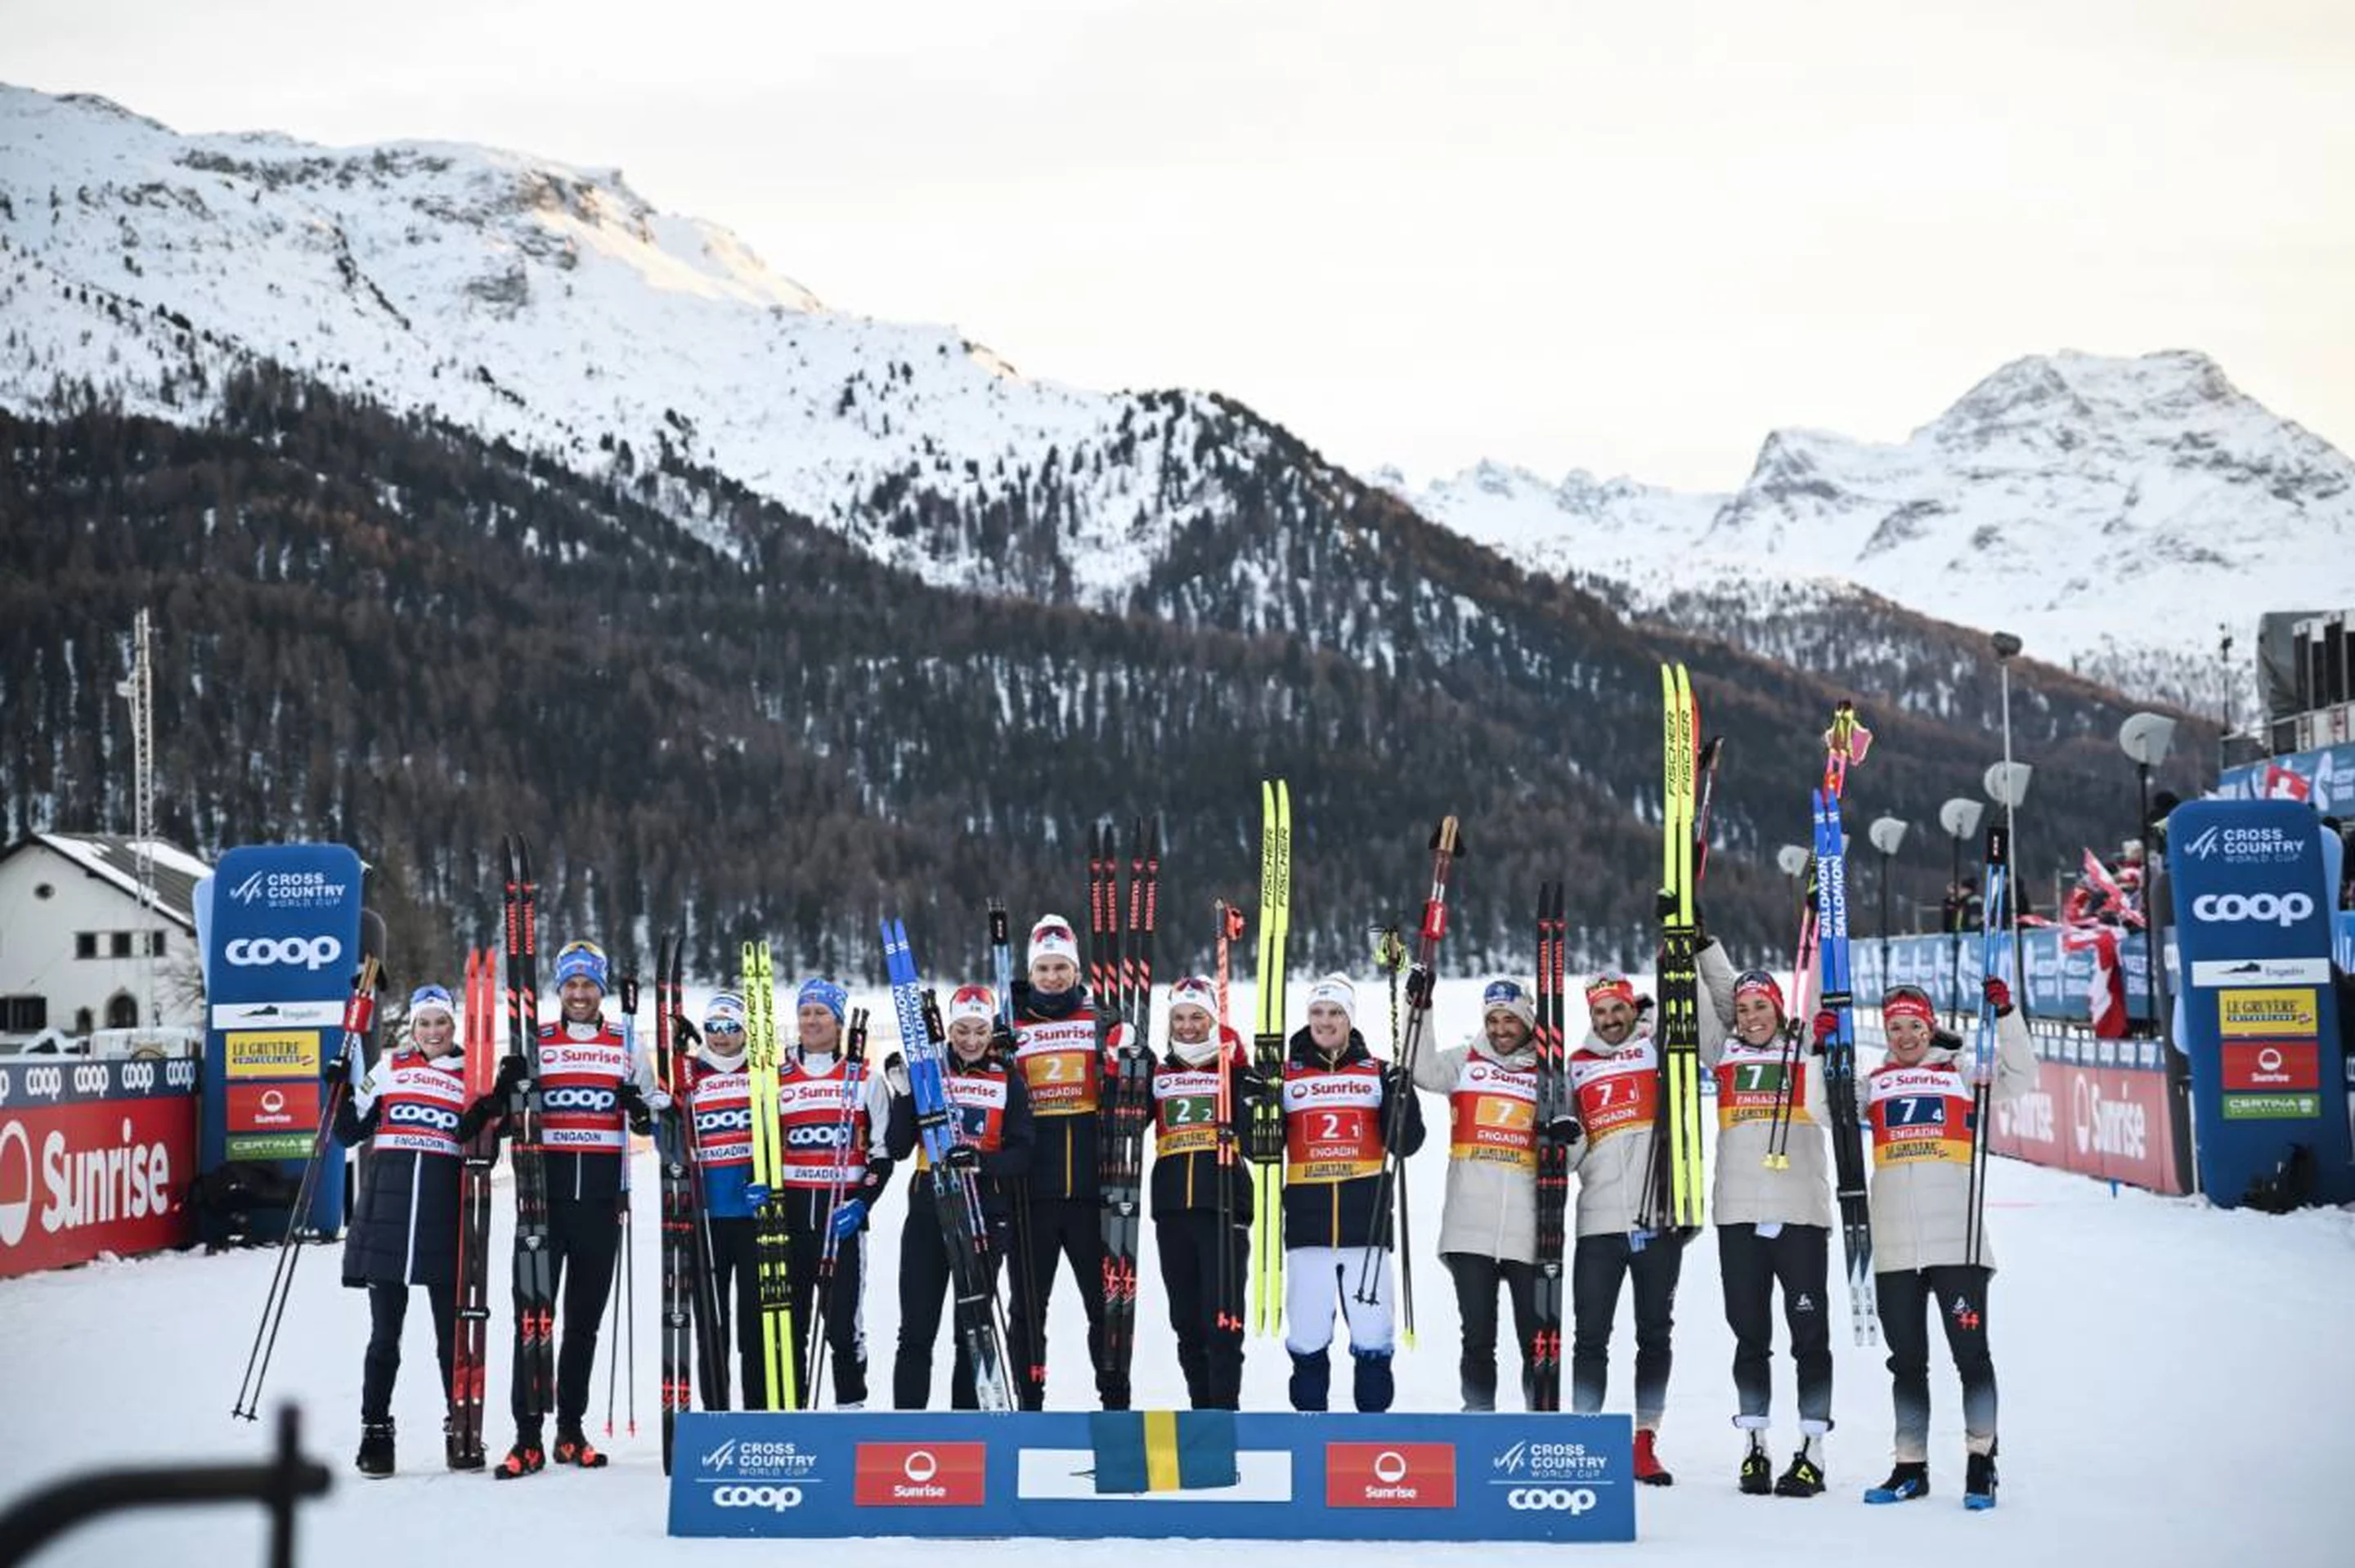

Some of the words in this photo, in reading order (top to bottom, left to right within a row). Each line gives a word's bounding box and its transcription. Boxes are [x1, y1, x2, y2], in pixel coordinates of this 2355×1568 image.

[1681, 710, 1690, 796] FISCHER
[2223, 828, 2283, 841] CROSS
[2223, 840, 2304, 854] COUNTRY
[1277, 826, 1288, 907] FISCHER
[267, 872, 325, 886] CROSS
[267, 884, 346, 898] COUNTRY
[1819, 858, 1832, 939] SALOMON
[1832, 855, 1846, 938] SALOMON
[2192, 892, 2314, 927] coop
[225, 935, 342, 970] coop
[746, 984, 759, 1068] FISCHER
[762, 983, 775, 1068] FISCHER
[894, 983, 919, 1063] SALOMON
[907, 981, 933, 1060] SALOMON
[1034, 1026, 1094, 1041] Sunrise
[561, 1050, 621, 1064] Sunrise
[123, 1063, 154, 1094] coop
[166, 1061, 195, 1091] coop
[1046, 1058, 1062, 1080] 2
[1746, 1065, 1763, 1090] 7
[25, 1067, 61, 1100] coop
[74, 1065, 109, 1099] coop
[1311, 1080, 1373, 1095] Sunrise
[1896, 1074, 1951, 1087] Sunrise
[544, 1089, 615, 1111] coop
[1596, 1083, 1613, 1105] 7
[389, 1104, 459, 1129] coop
[1176, 1099, 1191, 1122] 2
[1202, 1109, 1212, 1122] 2
[1497, 1101, 1514, 1123] 7
[1900, 1099, 1918, 1122] 7
[1931, 1109, 1943, 1121] 4
[2092, 1081, 2146, 1160] Sunrise
[553, 1131, 602, 1142] ENGADIN
[1321, 1114, 1340, 1139] 2
[1351, 1124, 1359, 1137] 1
[1889, 1127, 1945, 1141] ENGADIN
[393, 1136, 445, 1149] ENGADIN
[1477, 1130, 1529, 1146] ENGADIN
[1309, 1146, 1359, 1158] ENGADIN
[42, 1118, 170, 1233] Sunrise
[740, 1442, 796, 1454] CROSS
[1530, 1444, 1586, 1456] CROSS
[738, 1467, 780, 1476] WORLD
[784, 1467, 810, 1476] CUP
[739, 1454, 817, 1467] COUNTRY
[1530, 1456, 1608, 1469] COUNTRY
[1530, 1469, 1572, 1479] WORLD
[1577, 1469, 1601, 1478] CUP
[713, 1486, 803, 1512] coop
[894, 1484, 946, 1498] Sunrise
[1366, 1485, 1416, 1499] Sunrise
[1507, 1488, 1597, 1516] coop
